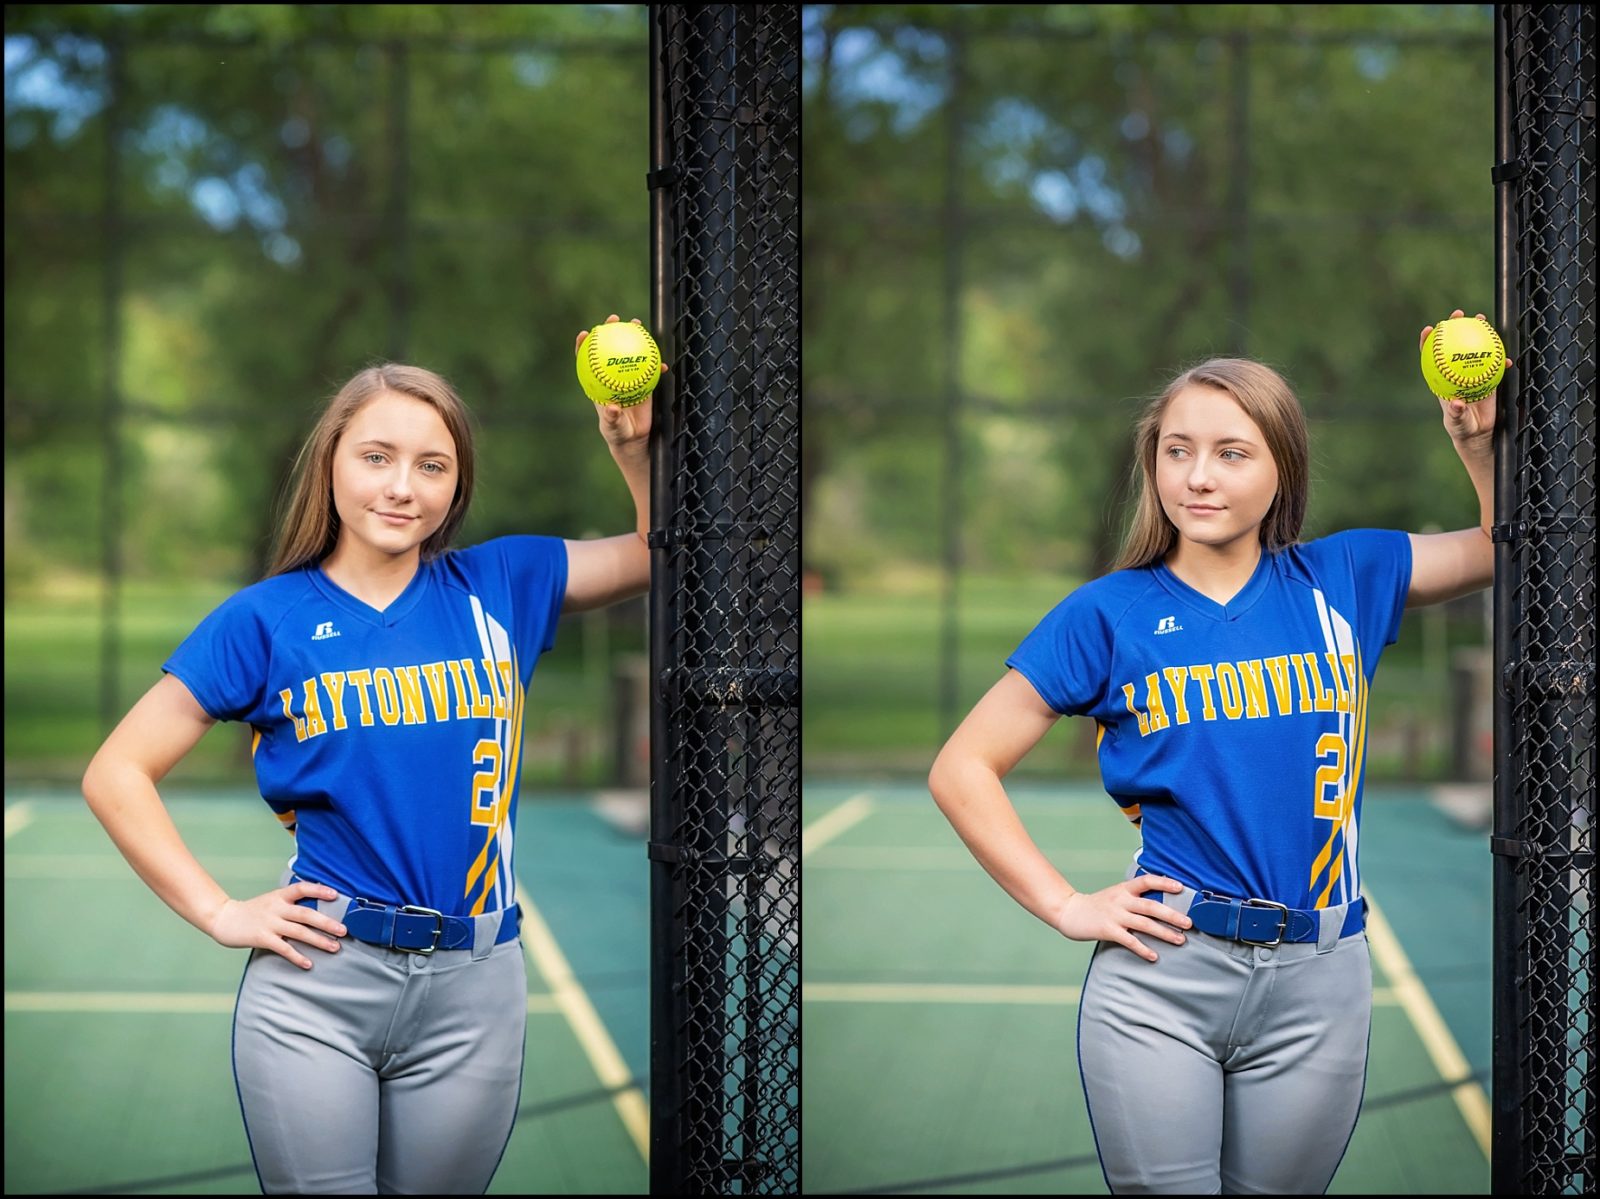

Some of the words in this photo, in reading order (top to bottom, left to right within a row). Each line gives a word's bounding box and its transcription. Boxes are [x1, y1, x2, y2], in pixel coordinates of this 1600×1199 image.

[606, 355, 648, 367] DUDLEY
[1451, 351, 1492, 362] DUDLEY
[470, 738, 503, 827] 2
[1313, 732, 1347, 821] 2
